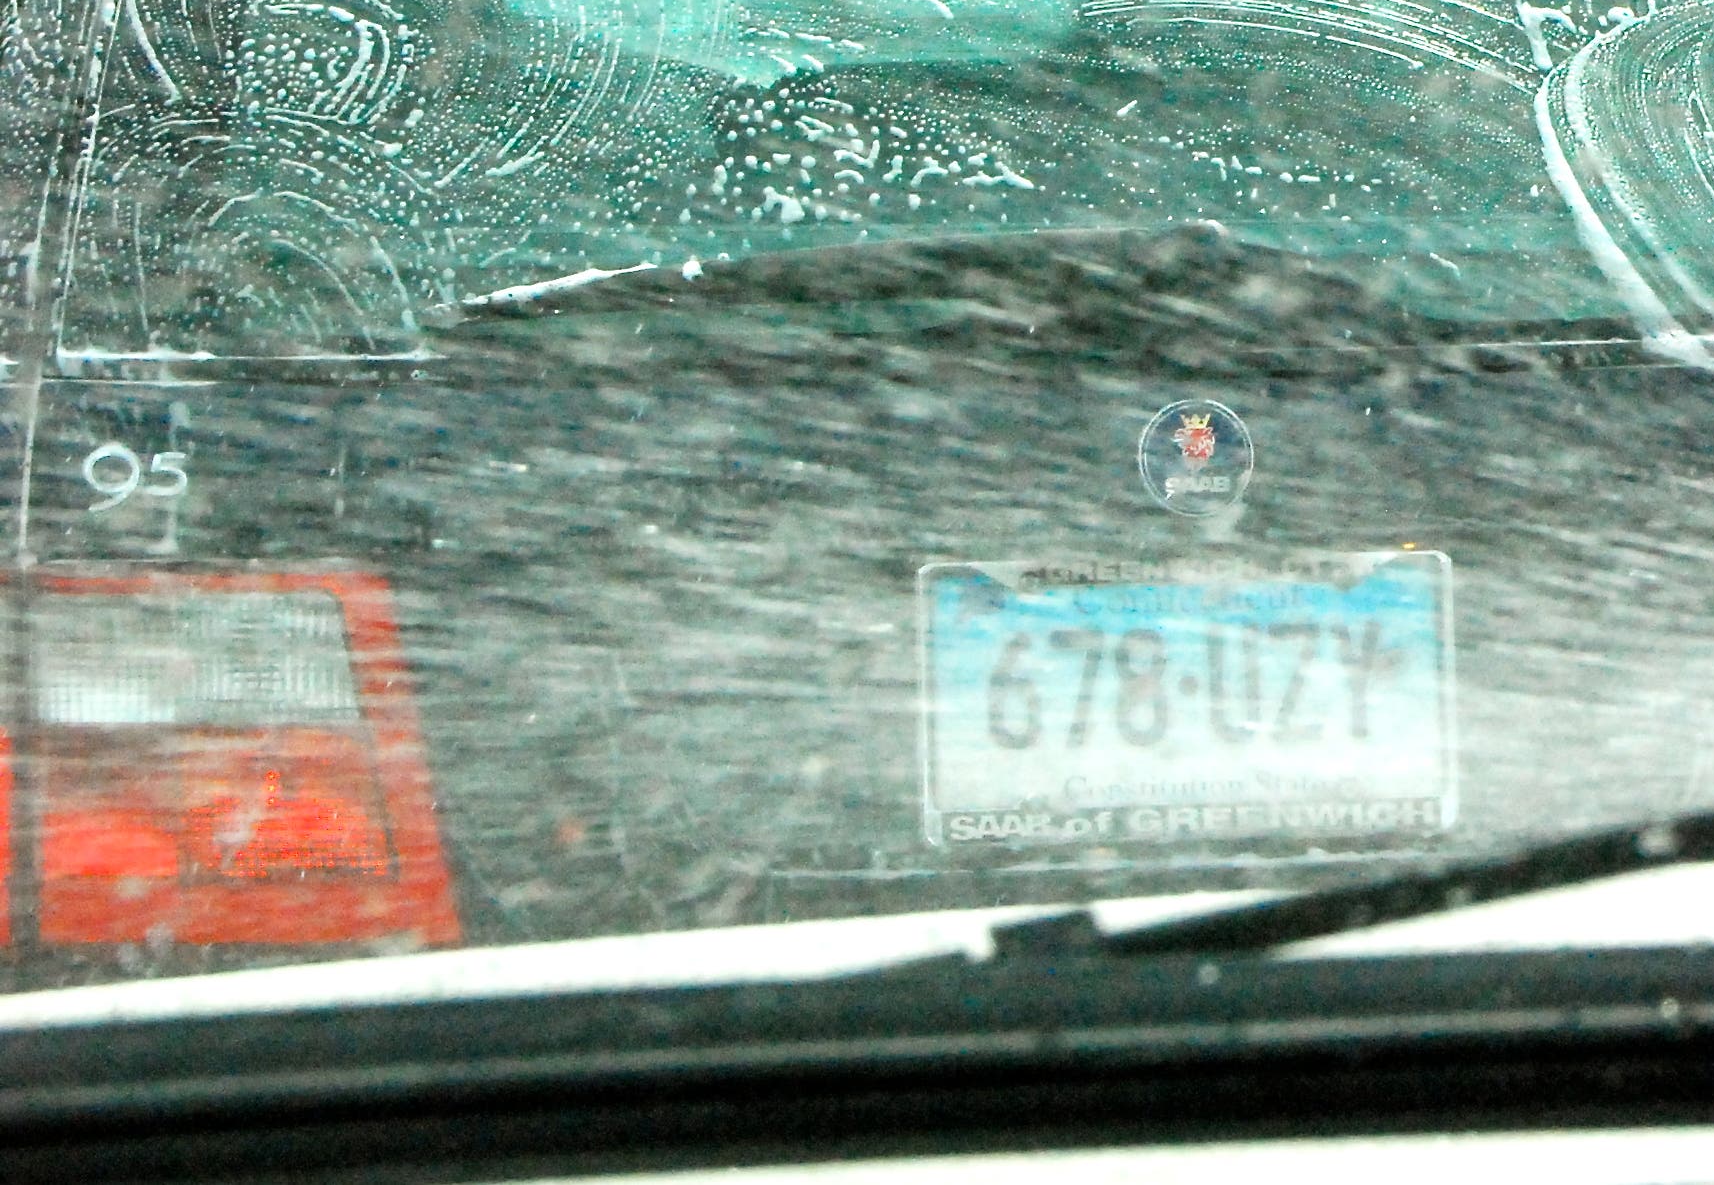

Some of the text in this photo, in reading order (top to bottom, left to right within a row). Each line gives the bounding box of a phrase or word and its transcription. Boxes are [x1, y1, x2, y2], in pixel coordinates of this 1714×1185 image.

[1164, 475, 1231, 493] SAAB
[949, 797, 1437, 842] SAAB of GREENWICH
